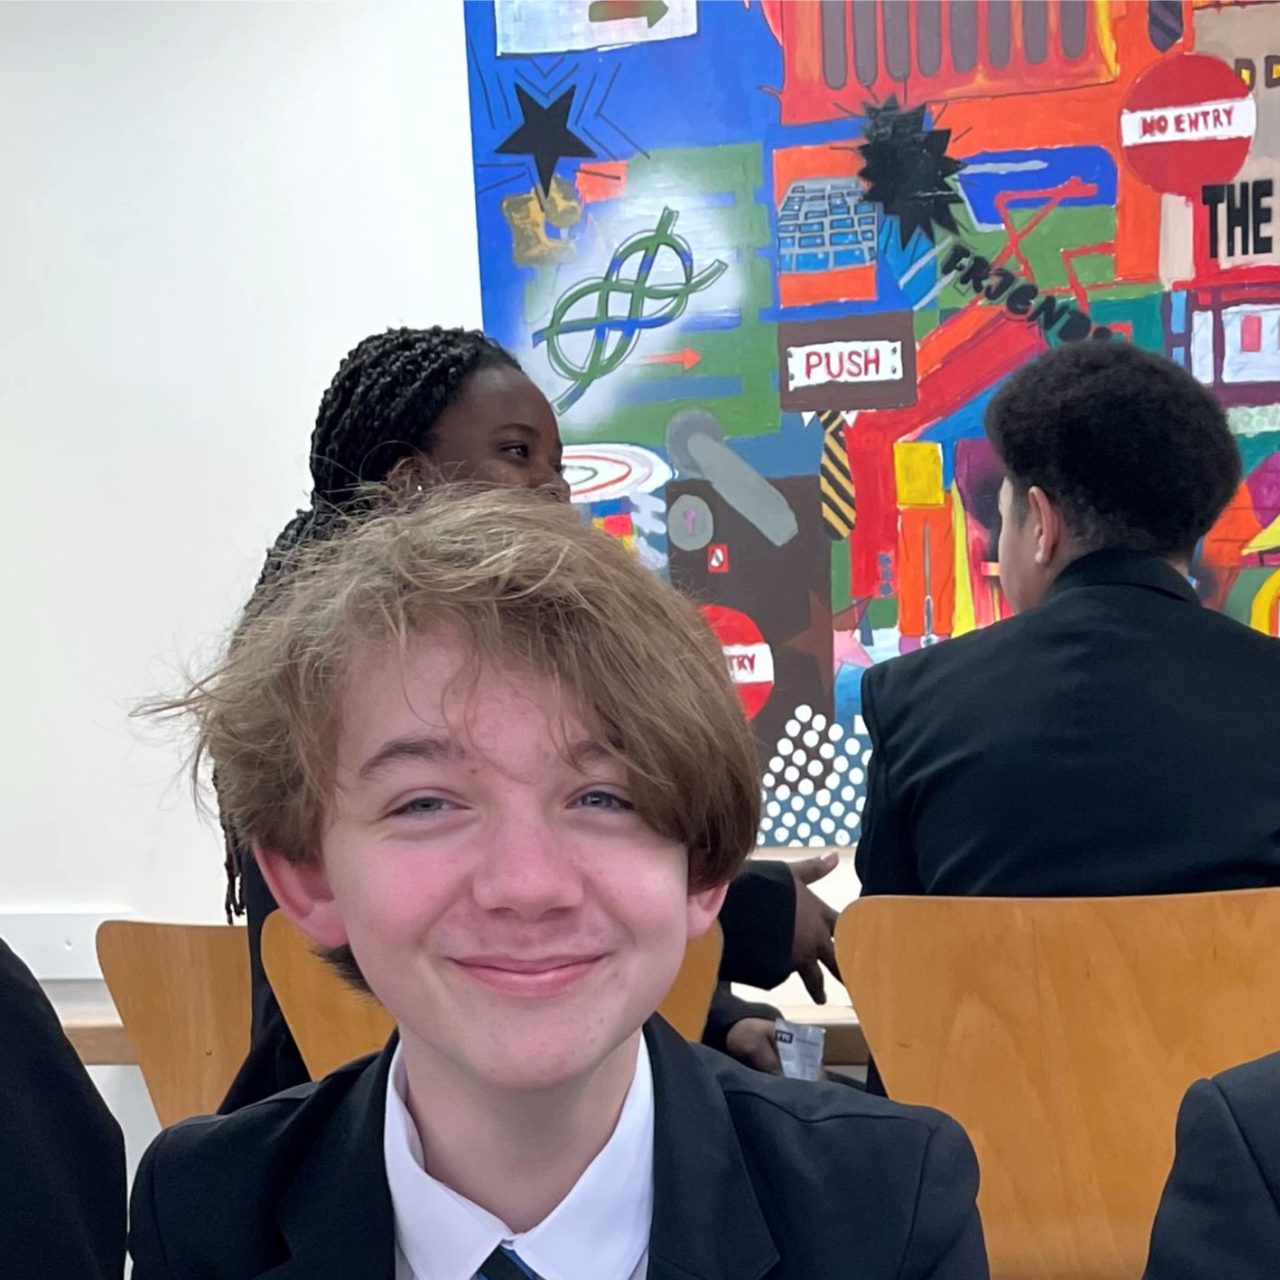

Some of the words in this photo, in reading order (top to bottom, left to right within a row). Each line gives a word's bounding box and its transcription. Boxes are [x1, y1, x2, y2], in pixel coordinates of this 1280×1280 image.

[1140, 114, 1168, 138] NO
[1174, 105, 1234, 133] ENTRY
[1202, 179, 1274, 258] THE
[805, 347, 880, 380] PUSH
